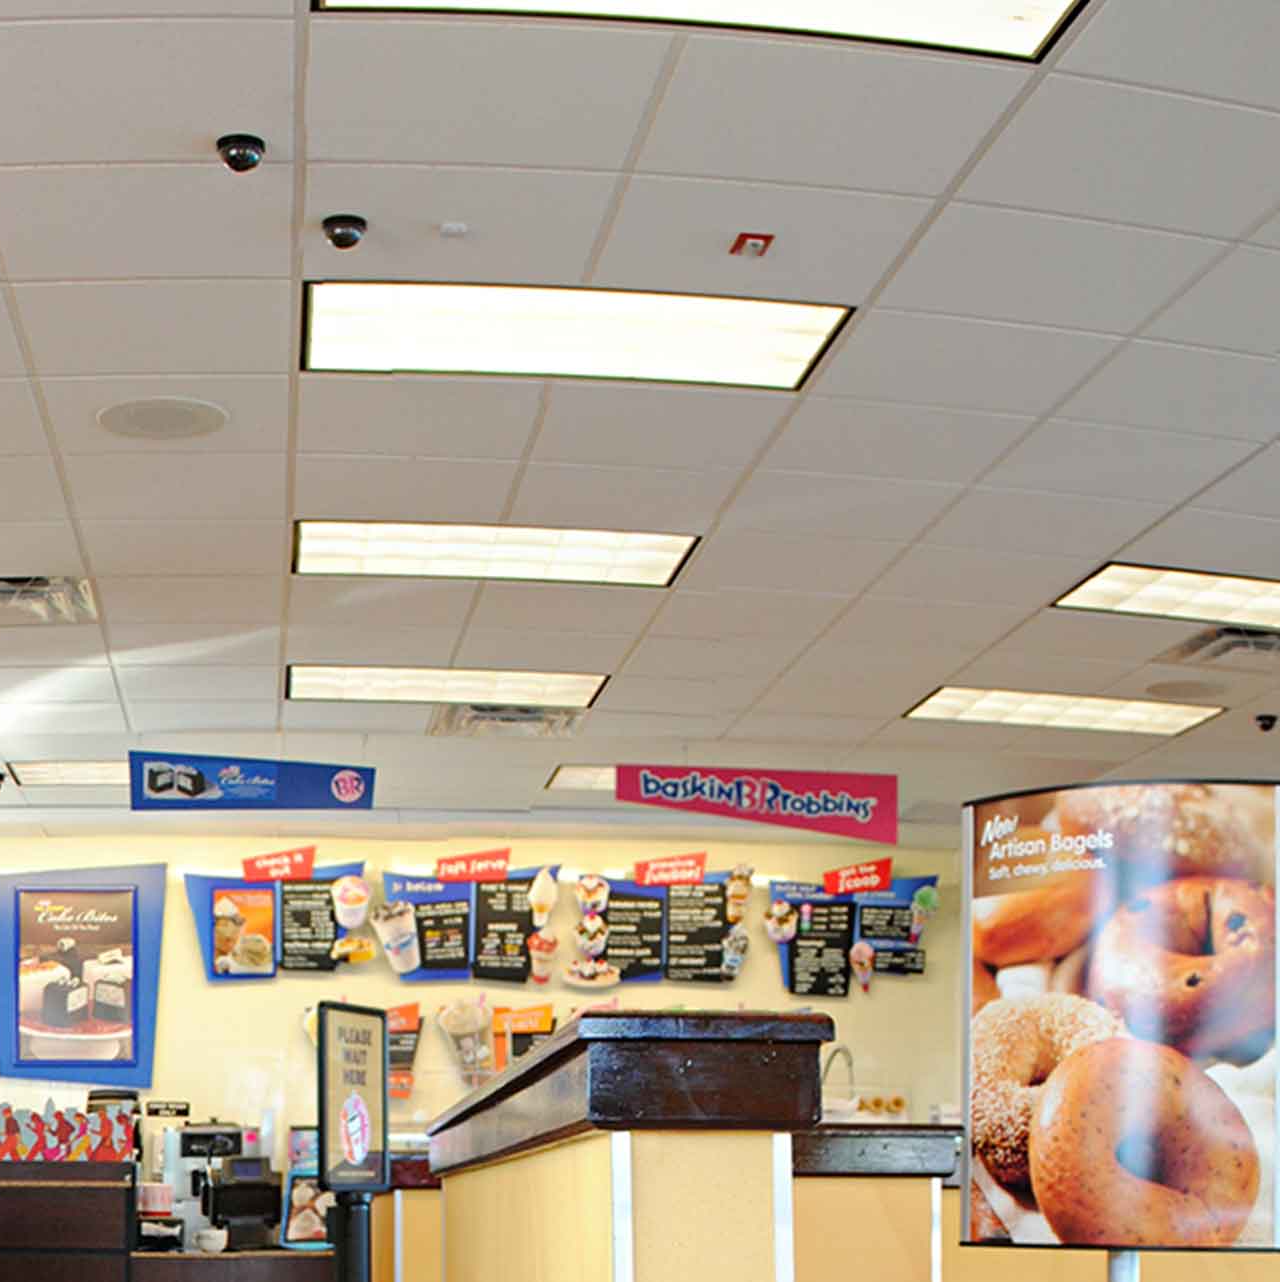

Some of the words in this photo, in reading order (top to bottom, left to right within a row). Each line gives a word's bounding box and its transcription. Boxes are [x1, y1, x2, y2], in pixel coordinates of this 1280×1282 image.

[989, 838, 1046, 861] Artisan
[1051, 829, 1113, 855] Bagels
[337, 1026, 372, 1045] PLEASE
[343, 1049, 368, 1065] WAIT
[343, 1069, 367, 1086] HERE
